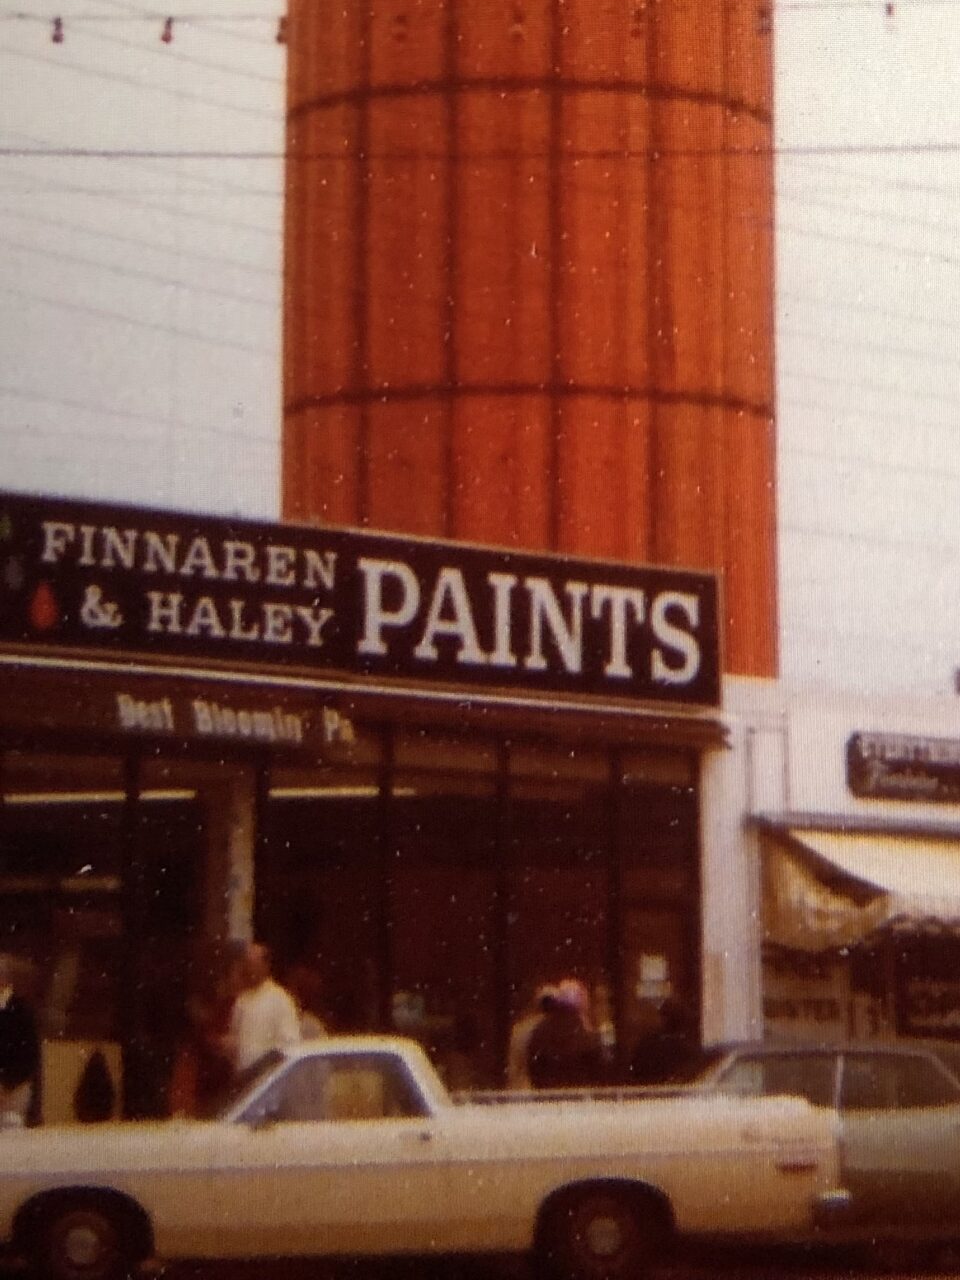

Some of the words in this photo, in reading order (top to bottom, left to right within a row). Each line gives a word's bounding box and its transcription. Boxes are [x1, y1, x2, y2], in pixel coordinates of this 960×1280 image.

[41, 521, 337, 590] FINNAREN
[80, 584, 123, 629] &
[147, 590, 335, 646] HALEY
[356, 557, 700, 685] PAINTS
